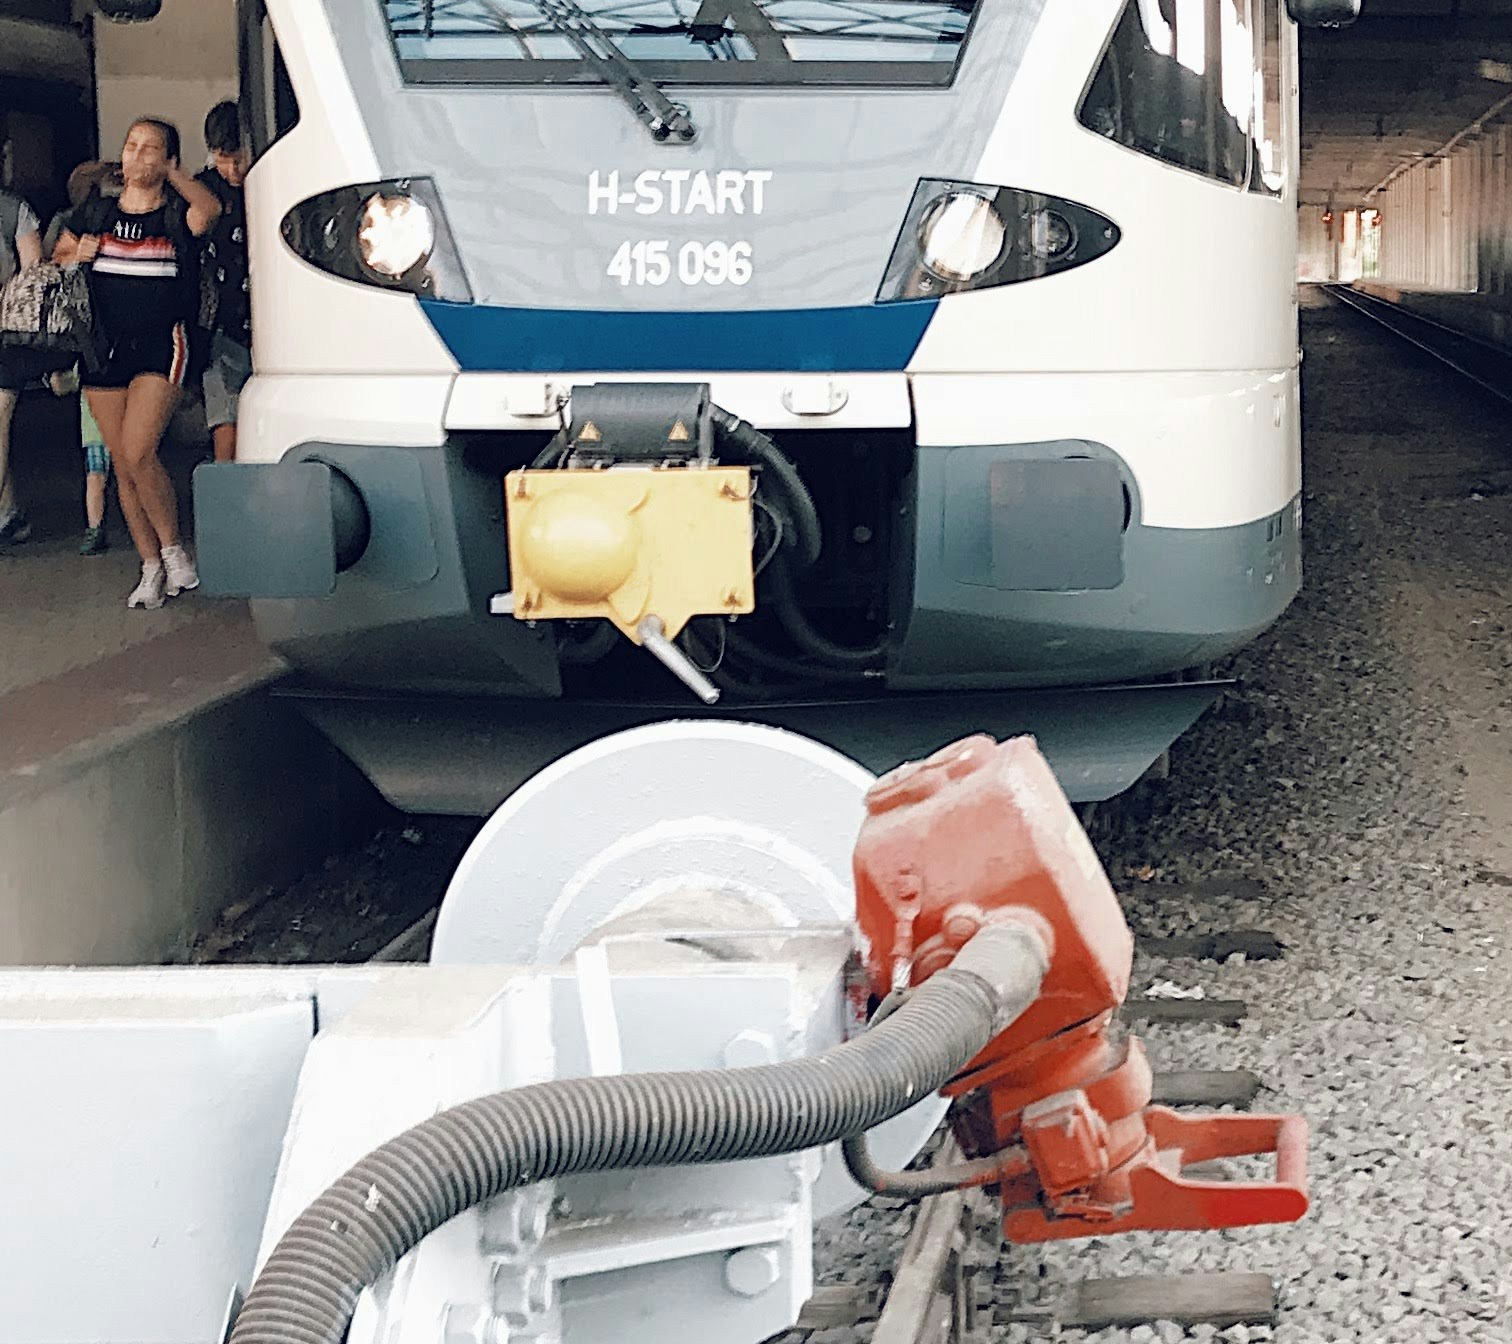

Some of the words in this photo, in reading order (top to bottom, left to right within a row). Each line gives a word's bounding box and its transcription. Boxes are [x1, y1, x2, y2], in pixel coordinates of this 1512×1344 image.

[588, 169, 773, 215] H-START
[606, 240, 671, 286] 415
[678, 240, 753, 286] 096
